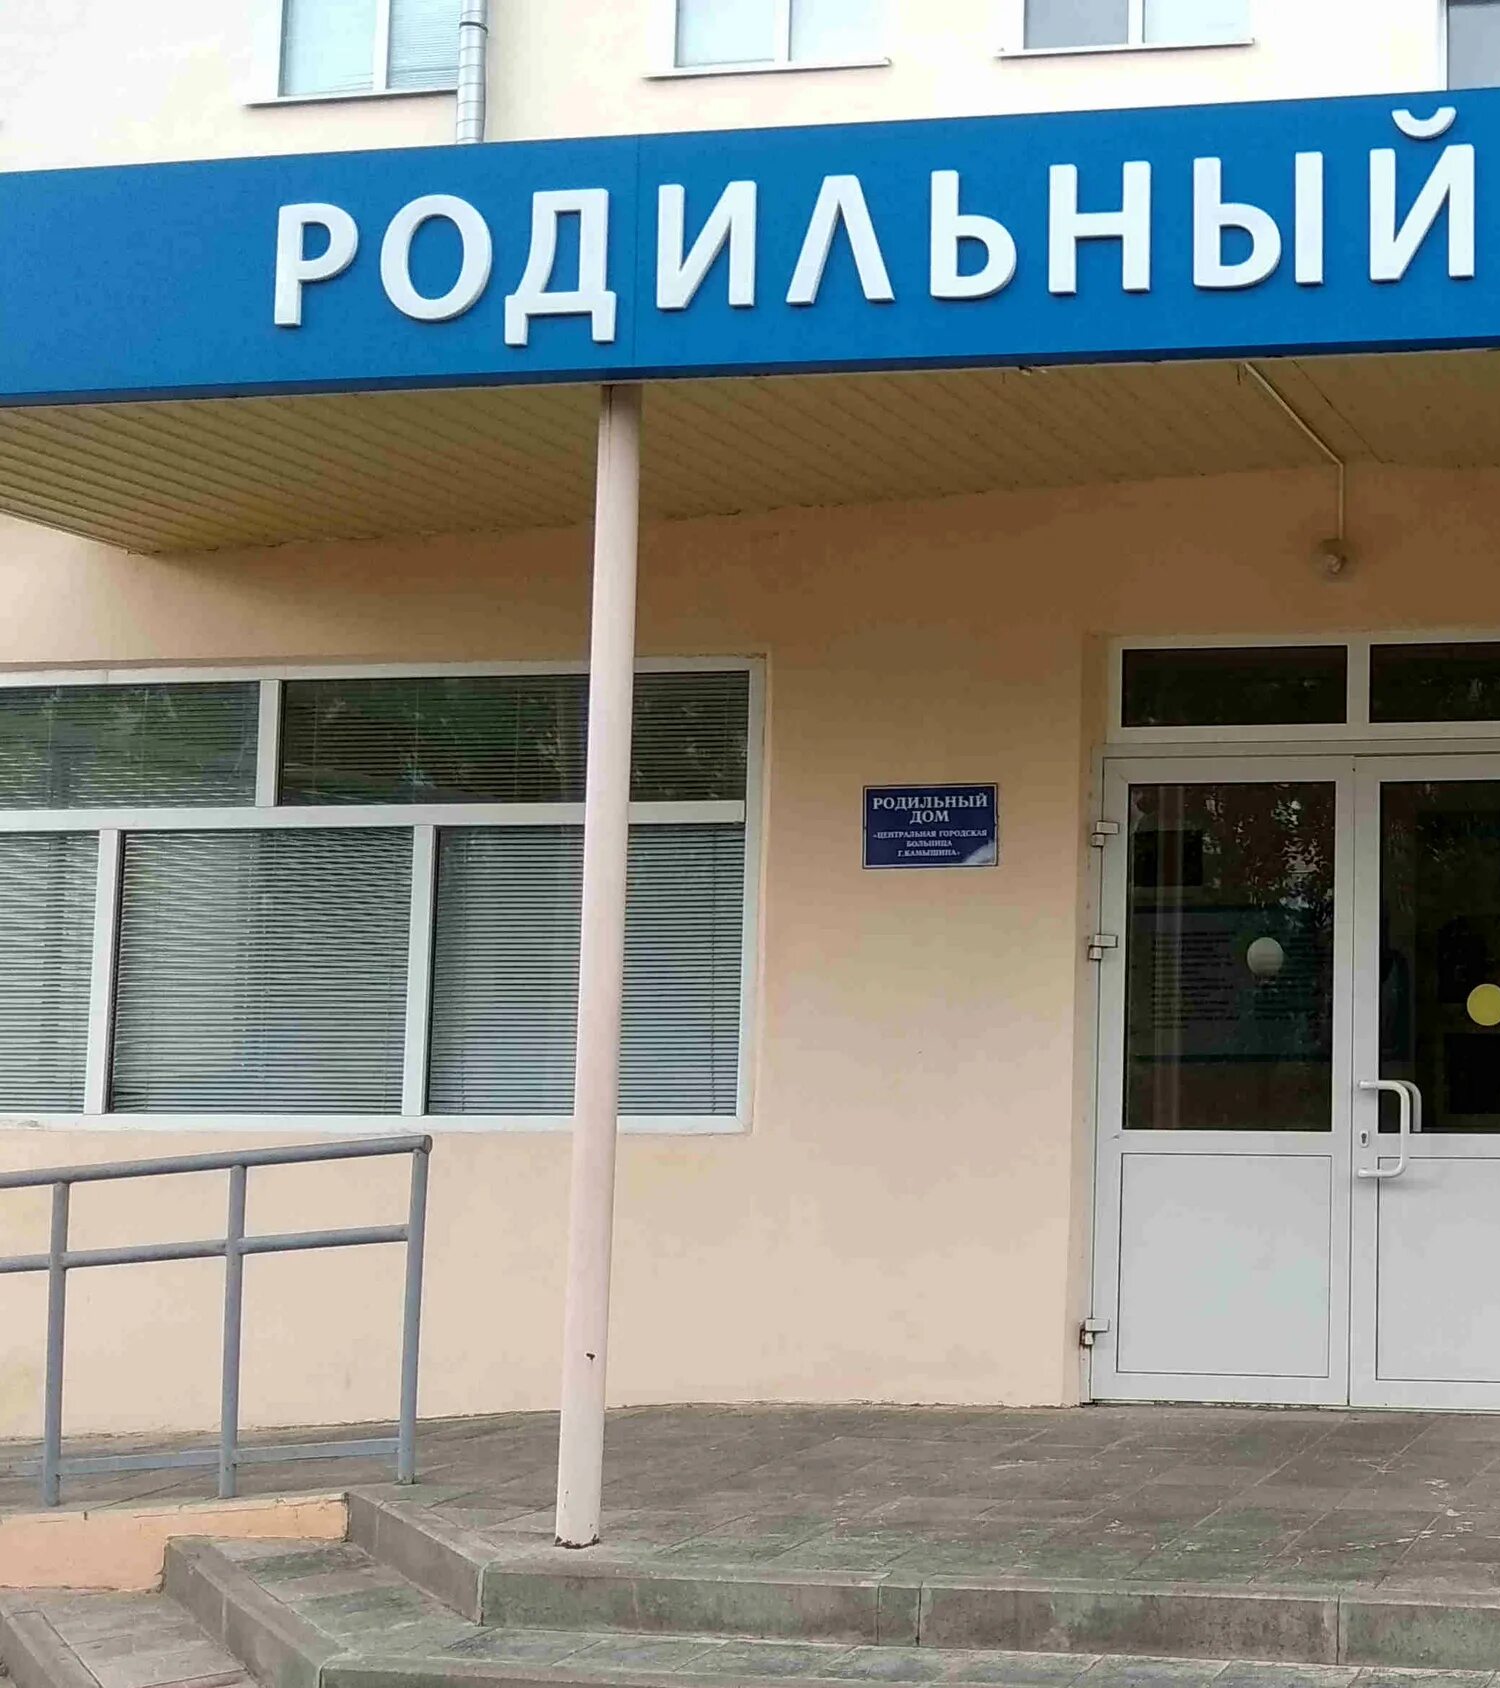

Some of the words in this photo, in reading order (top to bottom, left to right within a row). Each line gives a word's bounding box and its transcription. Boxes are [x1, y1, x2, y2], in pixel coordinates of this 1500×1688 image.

[275, 107, 1475, 345] РОДИЛЬНЫЙ
[872, 793, 989, 810] РОДИЛЬНЫЙ
[910, 810, 950, 824] ДОМ
[939, 829, 988, 838] ГОРОДСКАЯ
[906, 840, 953, 848] БОЛЬНИЦА
